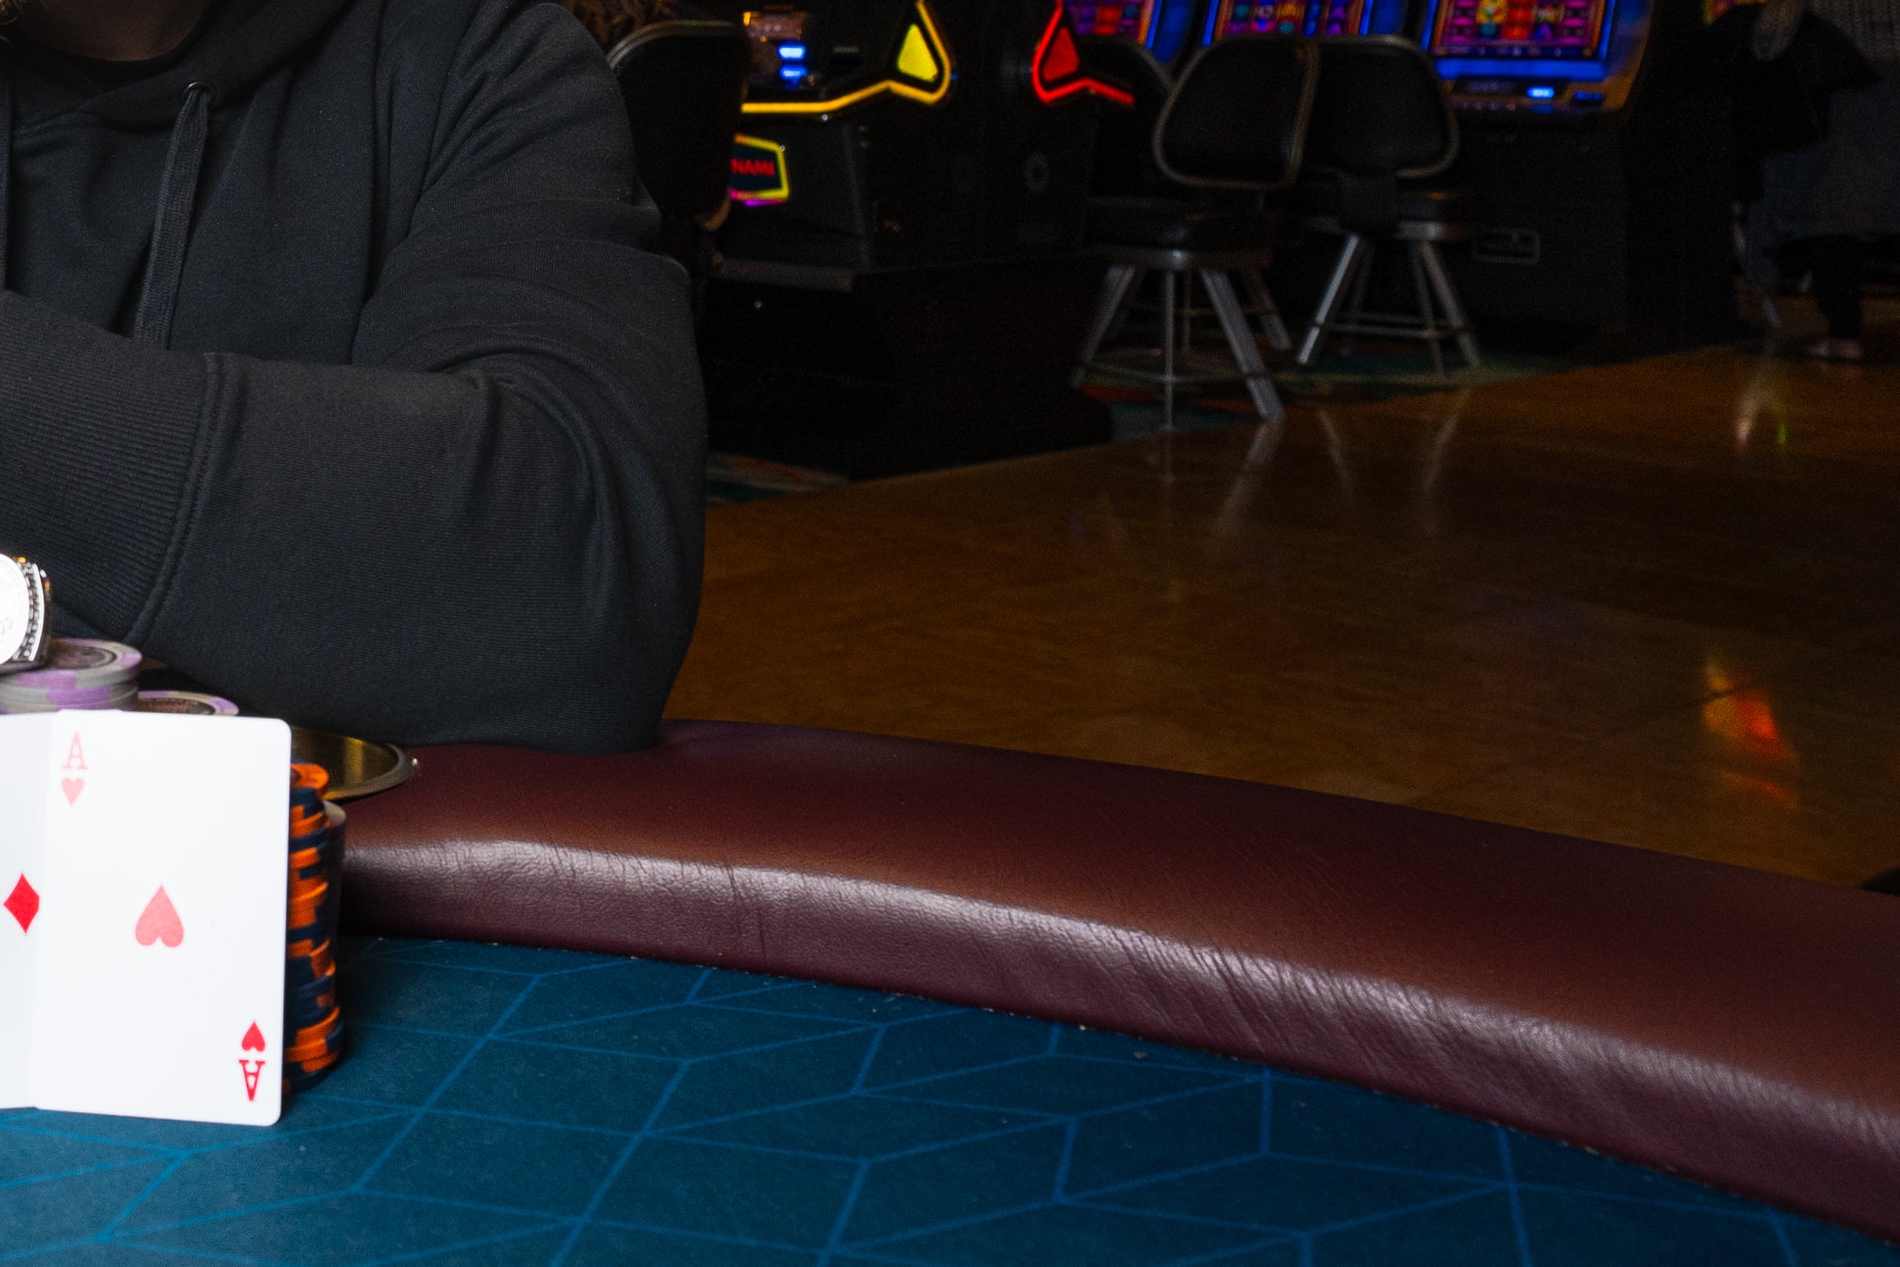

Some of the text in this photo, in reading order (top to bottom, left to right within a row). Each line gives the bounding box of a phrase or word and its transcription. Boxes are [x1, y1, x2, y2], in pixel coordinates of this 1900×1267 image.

[729, 158, 775, 176] NAMI
[62, 732, 88, 771] A
[238, 1058, 266, 1102] A
